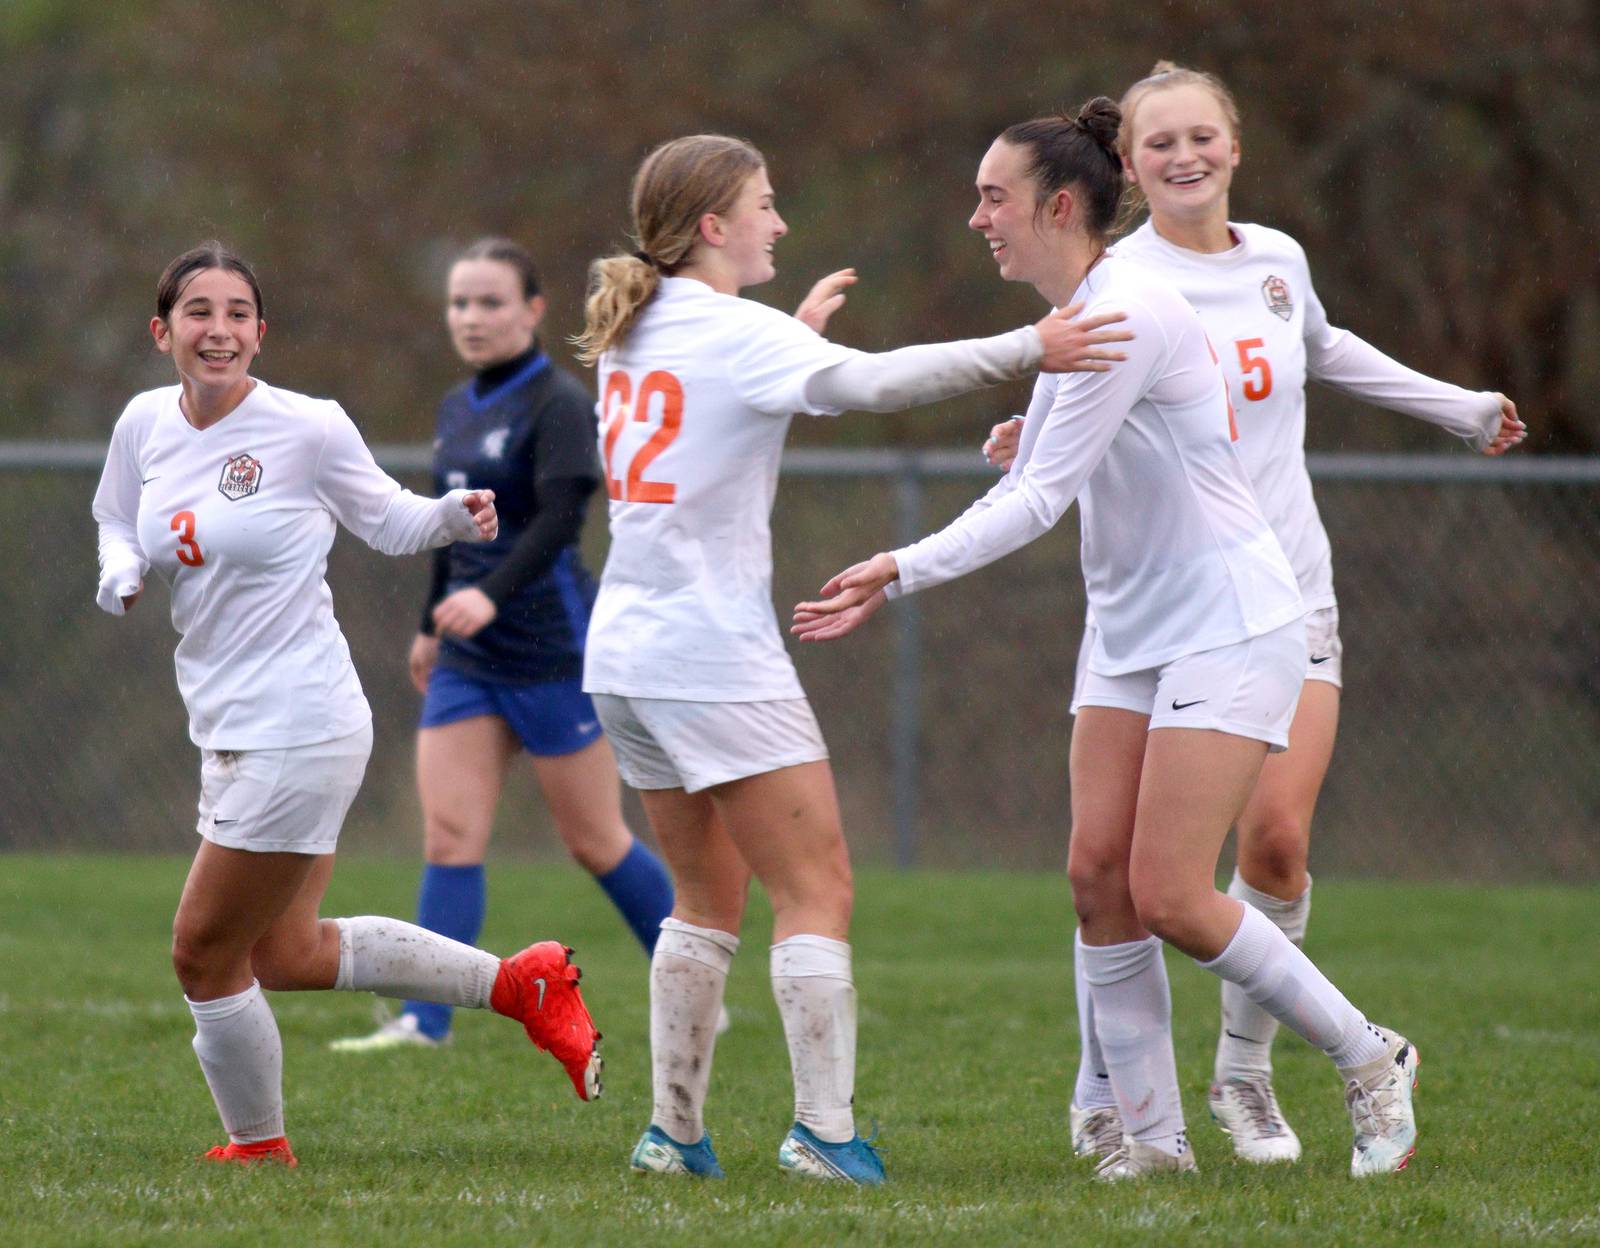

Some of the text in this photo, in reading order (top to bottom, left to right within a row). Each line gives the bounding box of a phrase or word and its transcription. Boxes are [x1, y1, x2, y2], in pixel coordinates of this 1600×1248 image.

[1235, 338, 1273, 402] 5
[603, 370, 684, 504] 22
[171, 511, 205, 567] 3
